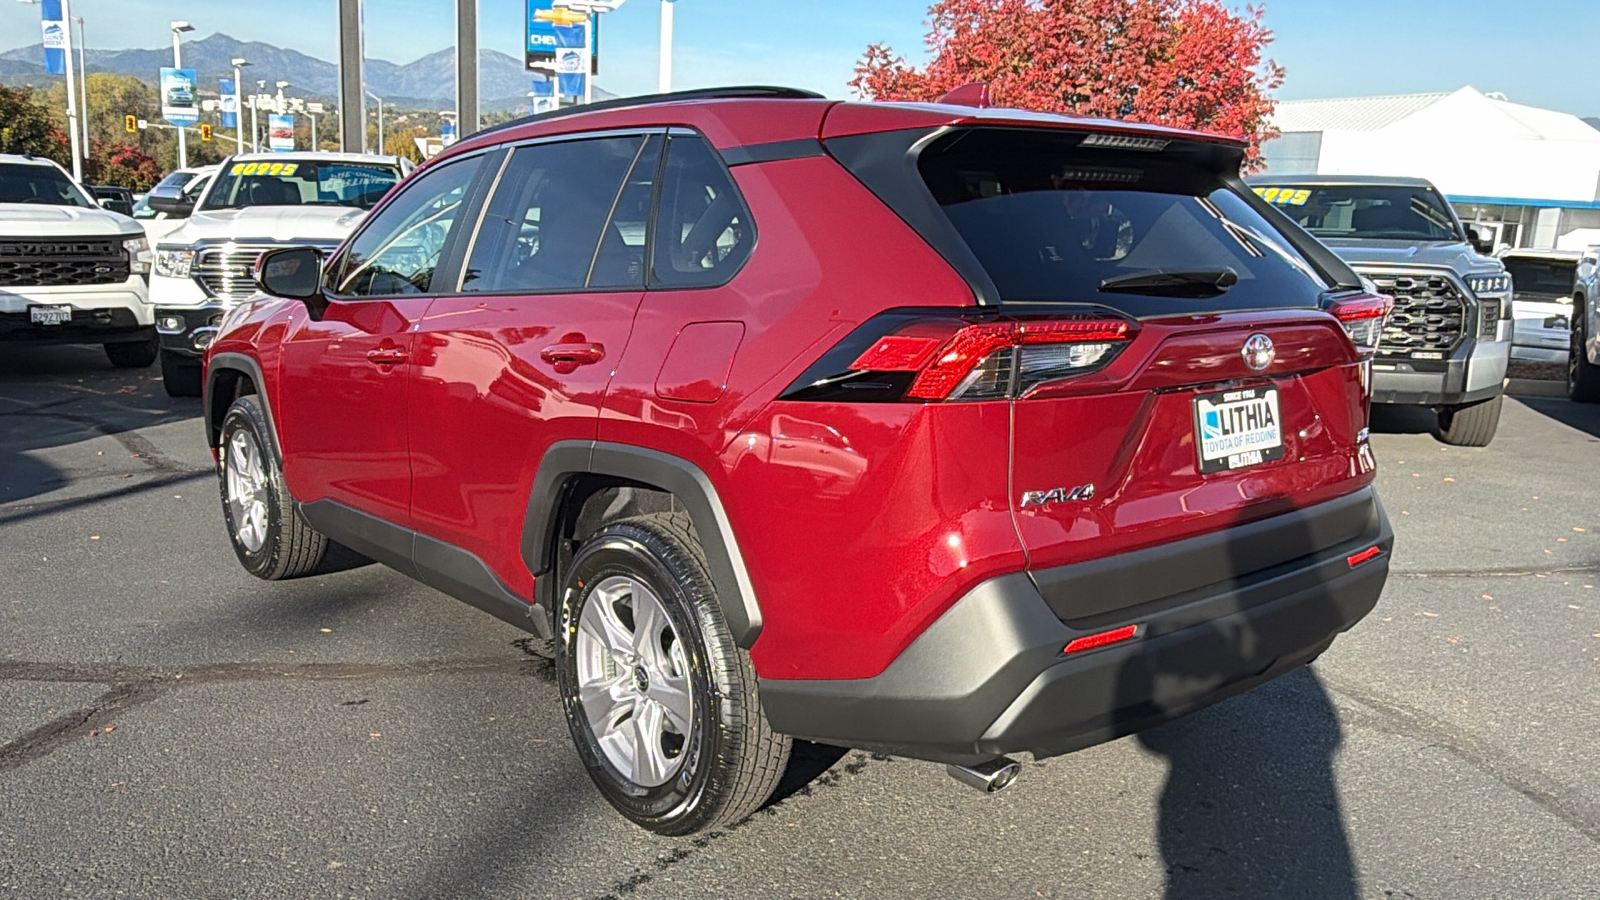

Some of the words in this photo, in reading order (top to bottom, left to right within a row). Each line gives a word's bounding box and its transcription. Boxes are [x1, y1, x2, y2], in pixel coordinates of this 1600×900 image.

[1219, 401, 1275, 436] LITHIA
[1205, 439, 1233, 453] TOYOTA
[1234, 436, 1243, 447] OF
[1245, 429, 1277, 445] REDDING
[1020, 483, 1094, 508] RAV4
